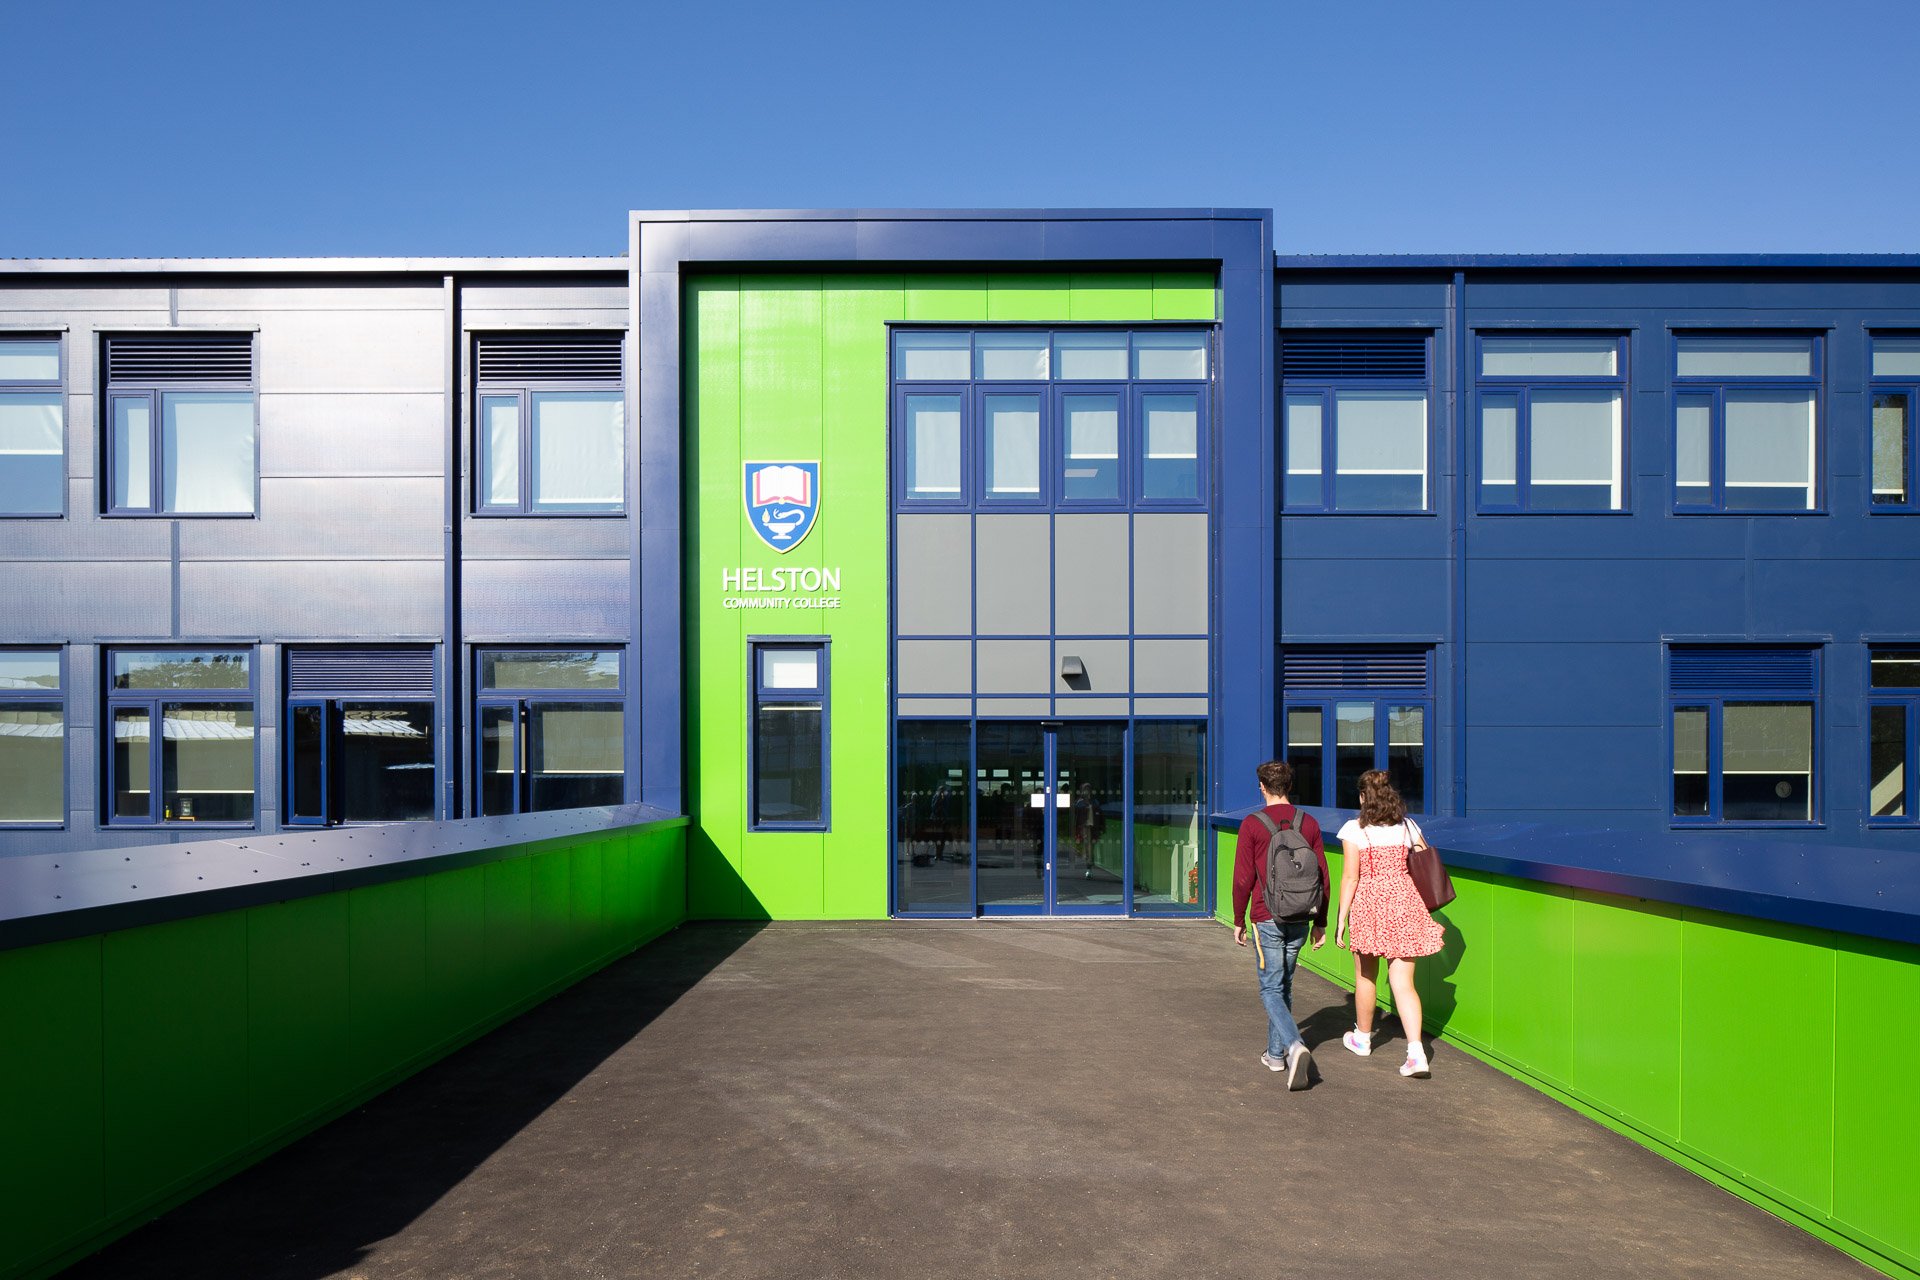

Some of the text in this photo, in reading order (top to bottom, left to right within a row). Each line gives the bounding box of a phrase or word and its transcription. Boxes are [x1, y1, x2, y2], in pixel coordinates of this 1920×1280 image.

[722, 567, 841, 592] HELSTON
[722, 597, 841, 609] COMMUNITY COLLEGE
